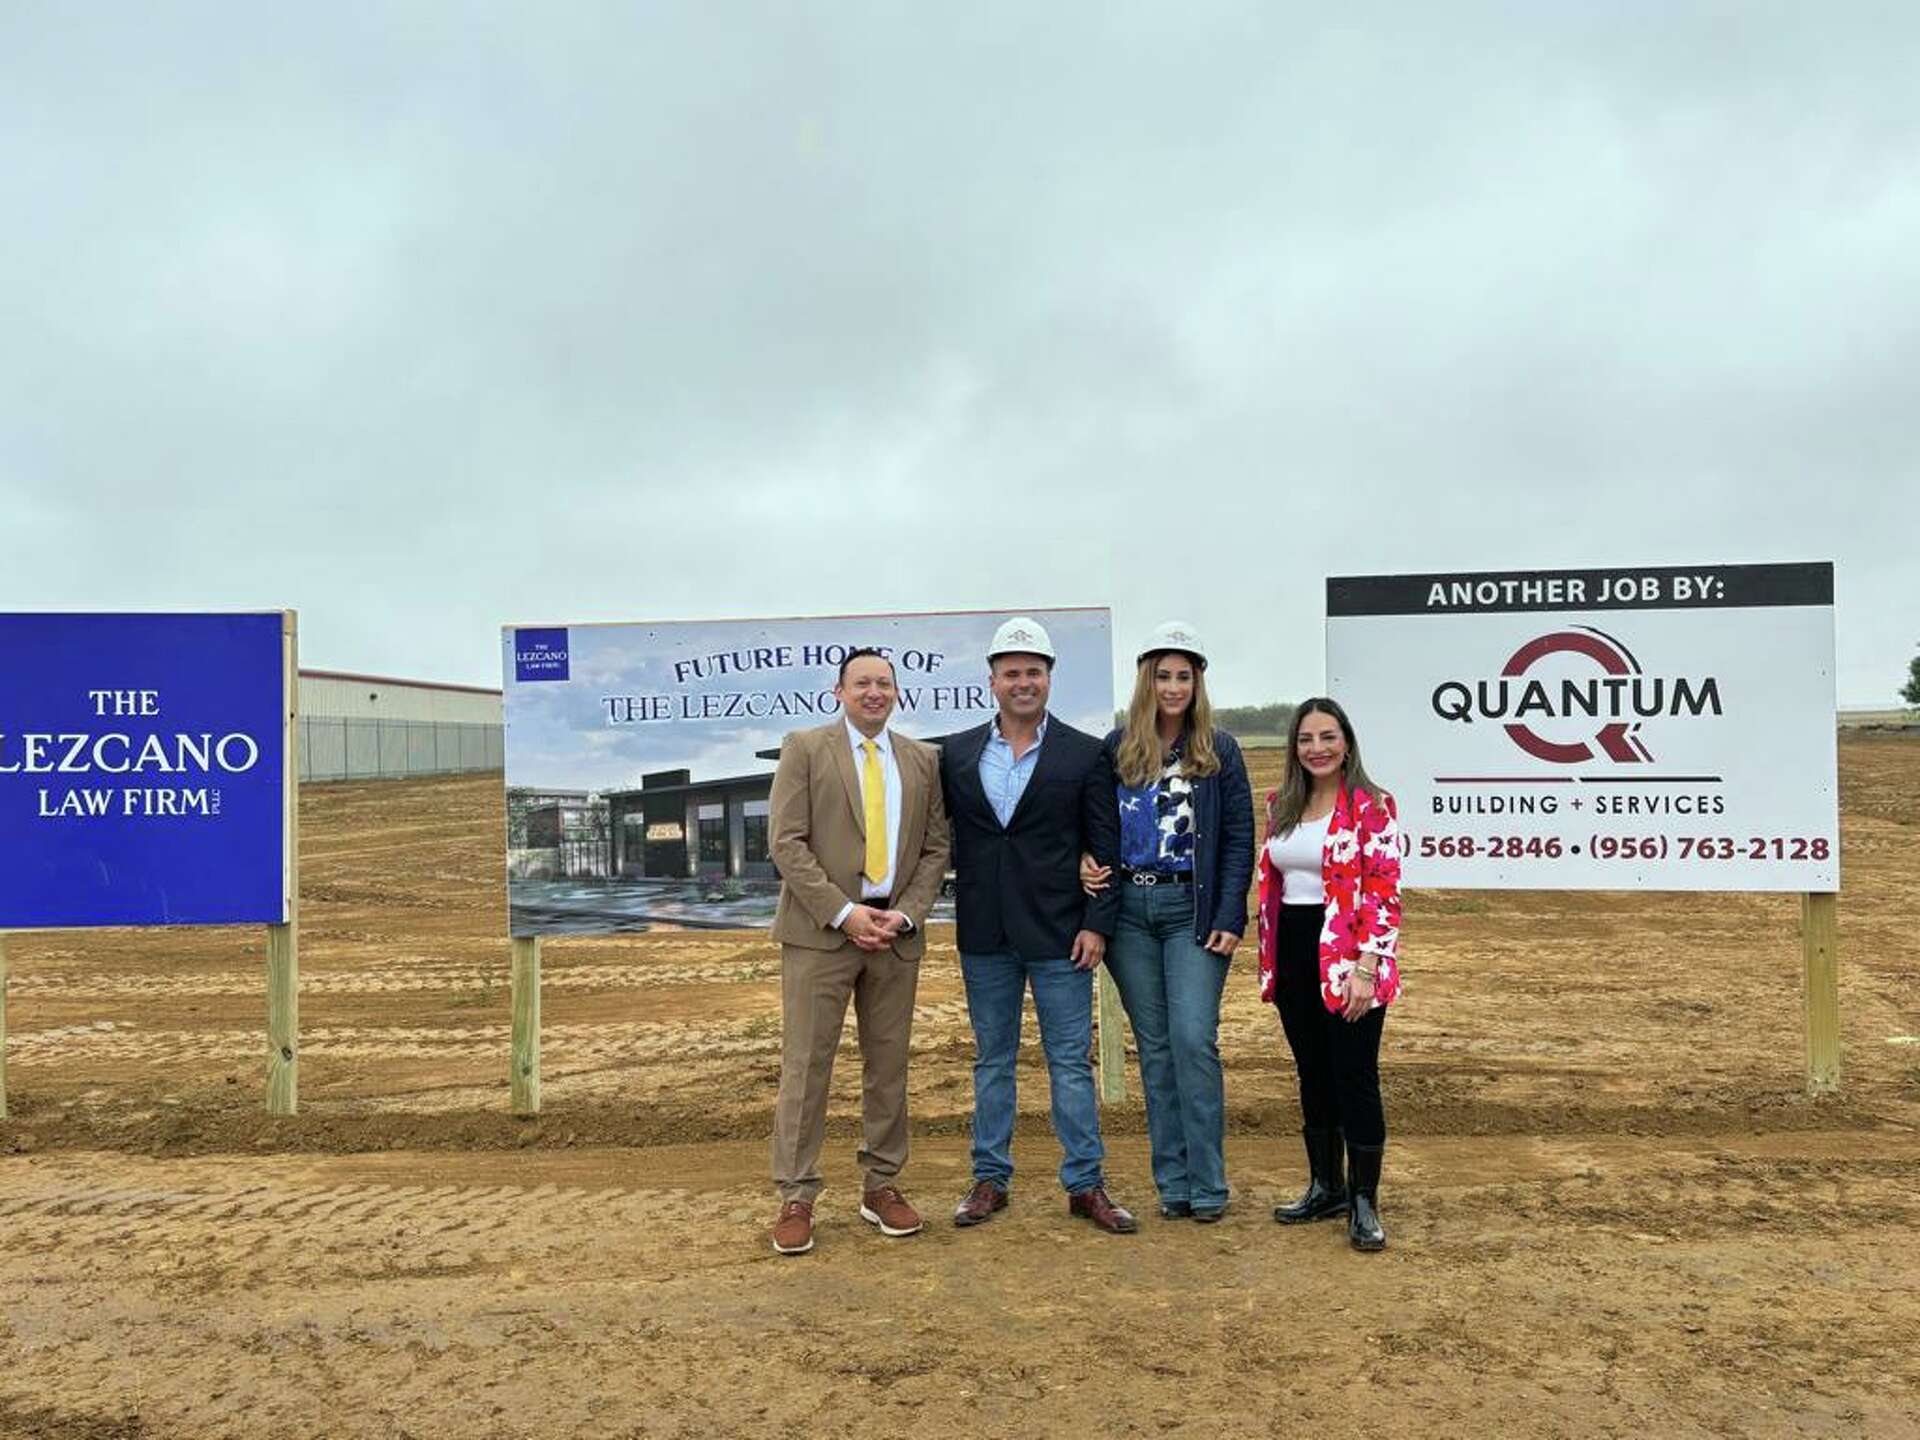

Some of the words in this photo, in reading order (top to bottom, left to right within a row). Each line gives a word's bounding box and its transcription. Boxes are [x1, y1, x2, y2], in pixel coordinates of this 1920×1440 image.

[1427, 579, 1586, 606] ANOTHER
[1597, 577, 1661, 602] JOB
[1673, 575, 1725, 600] BY:
[674, 645, 793, 683] FUTURE
[902, 649, 944, 674] OF
[88, 690, 161, 716] THE
[602, 696, 671, 723] THE
[682, 690, 841, 719] LEZCANO
[932, 685, 996, 710] FIR
[1431, 677, 1723, 723] QUANTUM
[38, 789, 113, 817] LAW
[122, 788, 211, 816] FIRM
[1432, 795, 1559, 815] BUILDING
[1595, 794, 1725, 815] SERVICES
[1420, 835, 1564, 859] 568-2846
[1589, 833, 1669, 860] (956)
[1676, 836, 1831, 861] 763-2128
